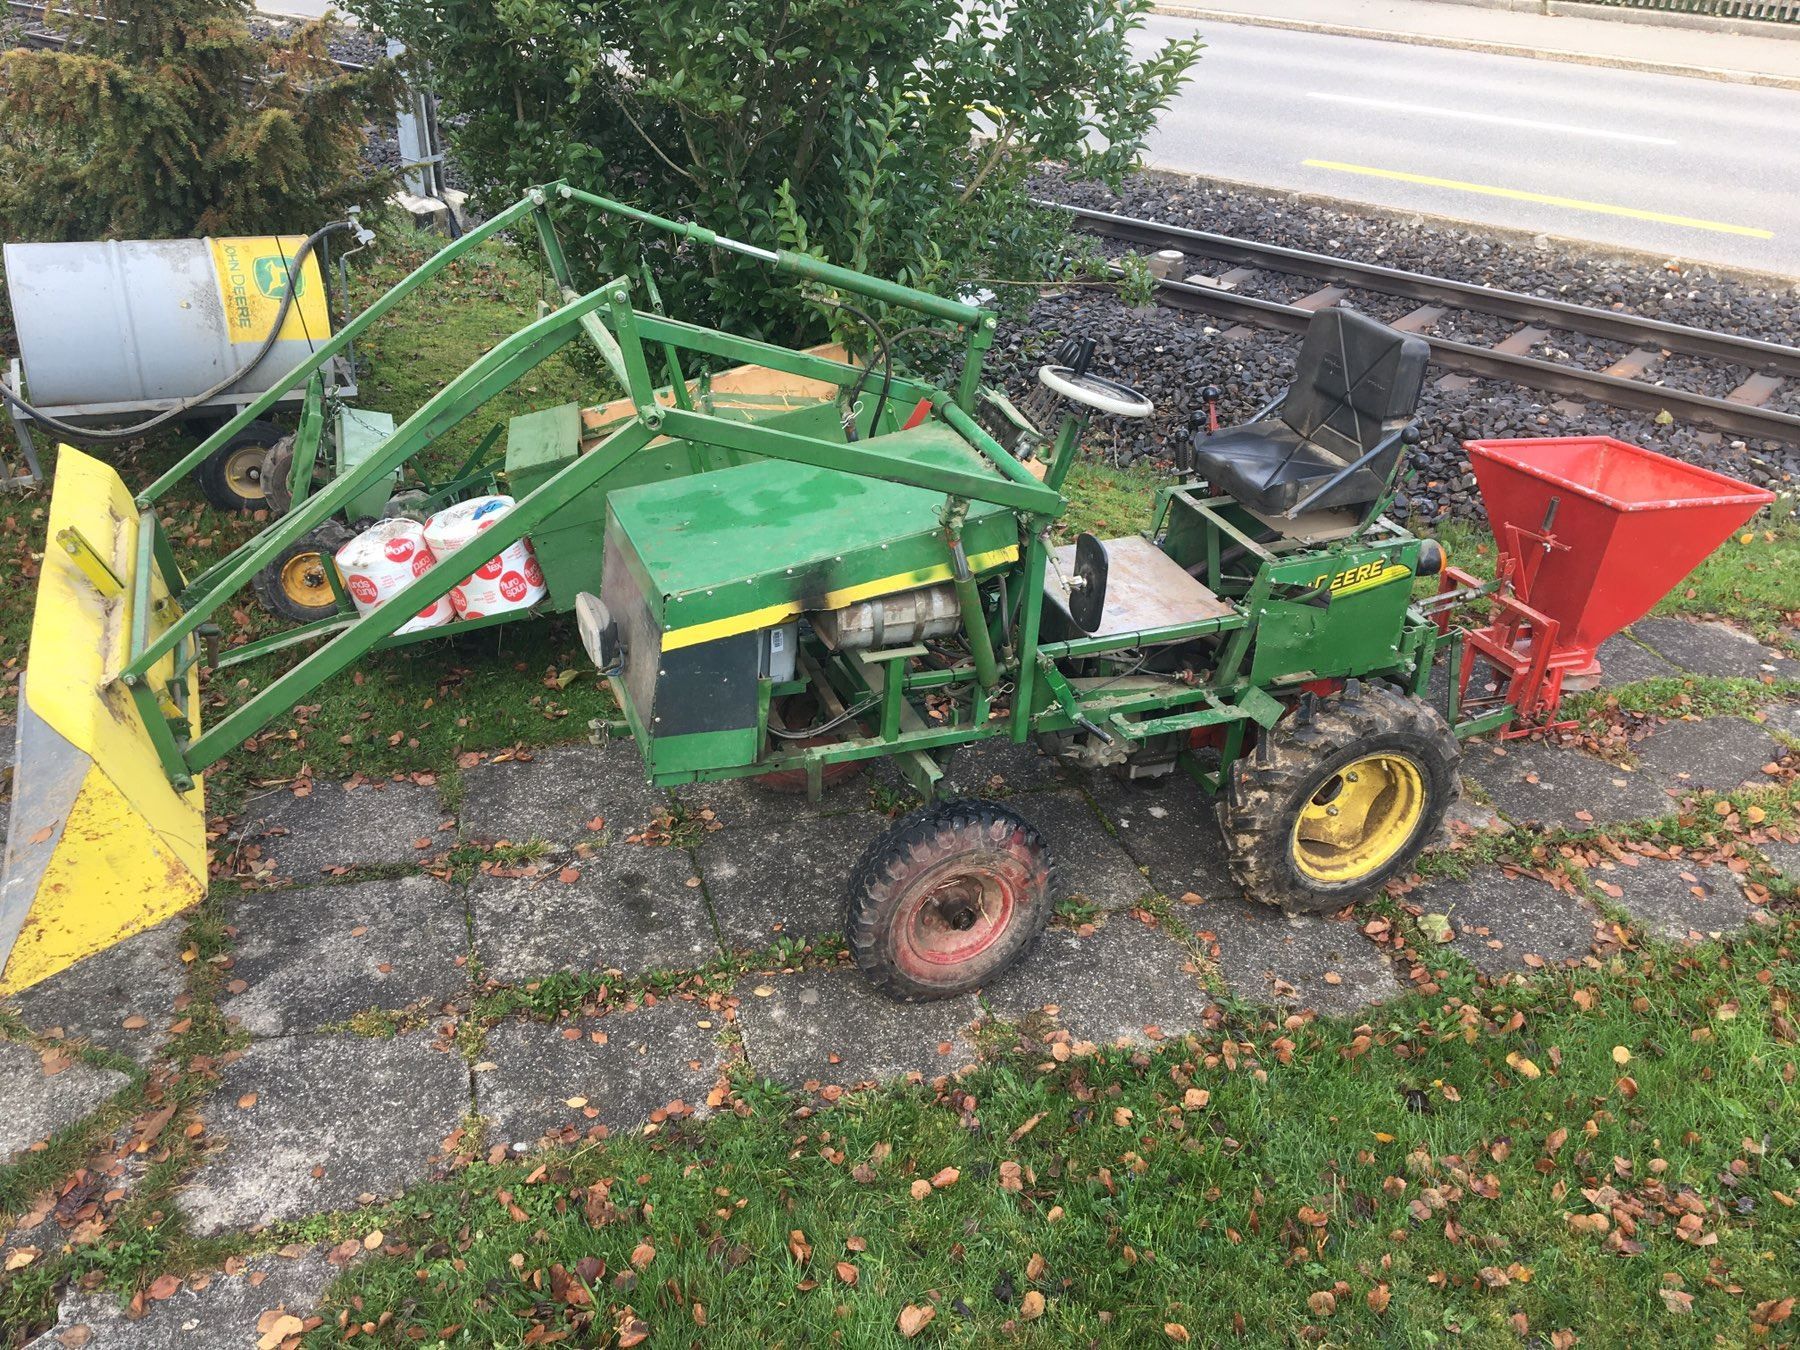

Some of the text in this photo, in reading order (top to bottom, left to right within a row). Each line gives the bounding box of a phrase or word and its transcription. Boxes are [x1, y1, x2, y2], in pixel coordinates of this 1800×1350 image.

[223, 243, 252, 329] JOHN DEERE
[500, 577, 519, 591] fluro
[505, 583, 527, 598] spun
